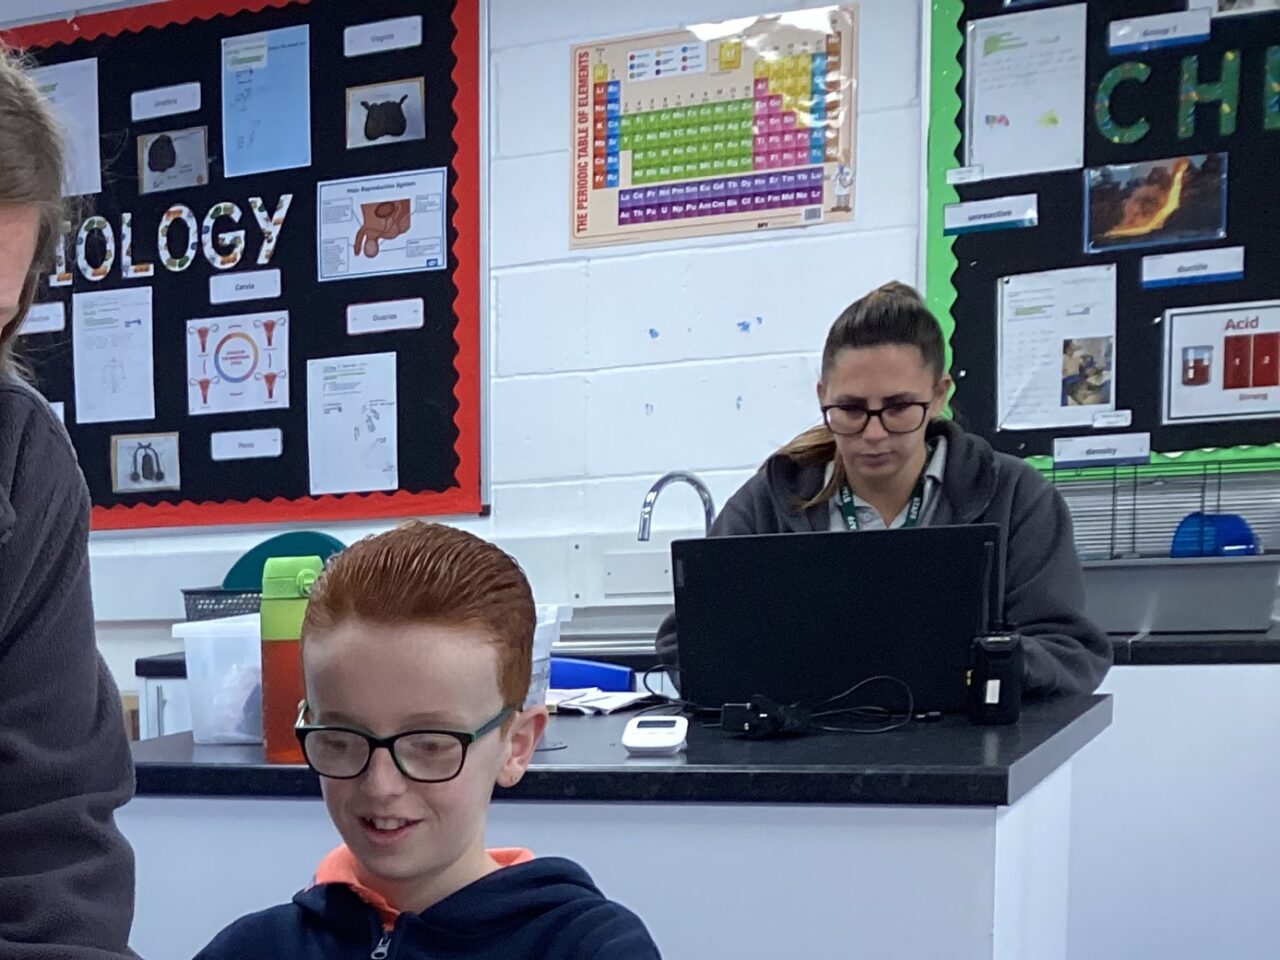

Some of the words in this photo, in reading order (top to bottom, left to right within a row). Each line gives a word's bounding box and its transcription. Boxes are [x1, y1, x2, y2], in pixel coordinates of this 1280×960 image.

[578, 51, 589, 107] ELEMENTS
[577, 110, 589, 124] OF
[577, 126, 589, 160] TABLE
[576, 161, 589, 210] PERIODIC
[576, 213, 588, 234] THE
[49, 194, 293, 288] IOLOGY
[1224, 316, 1260, 331] Acid
